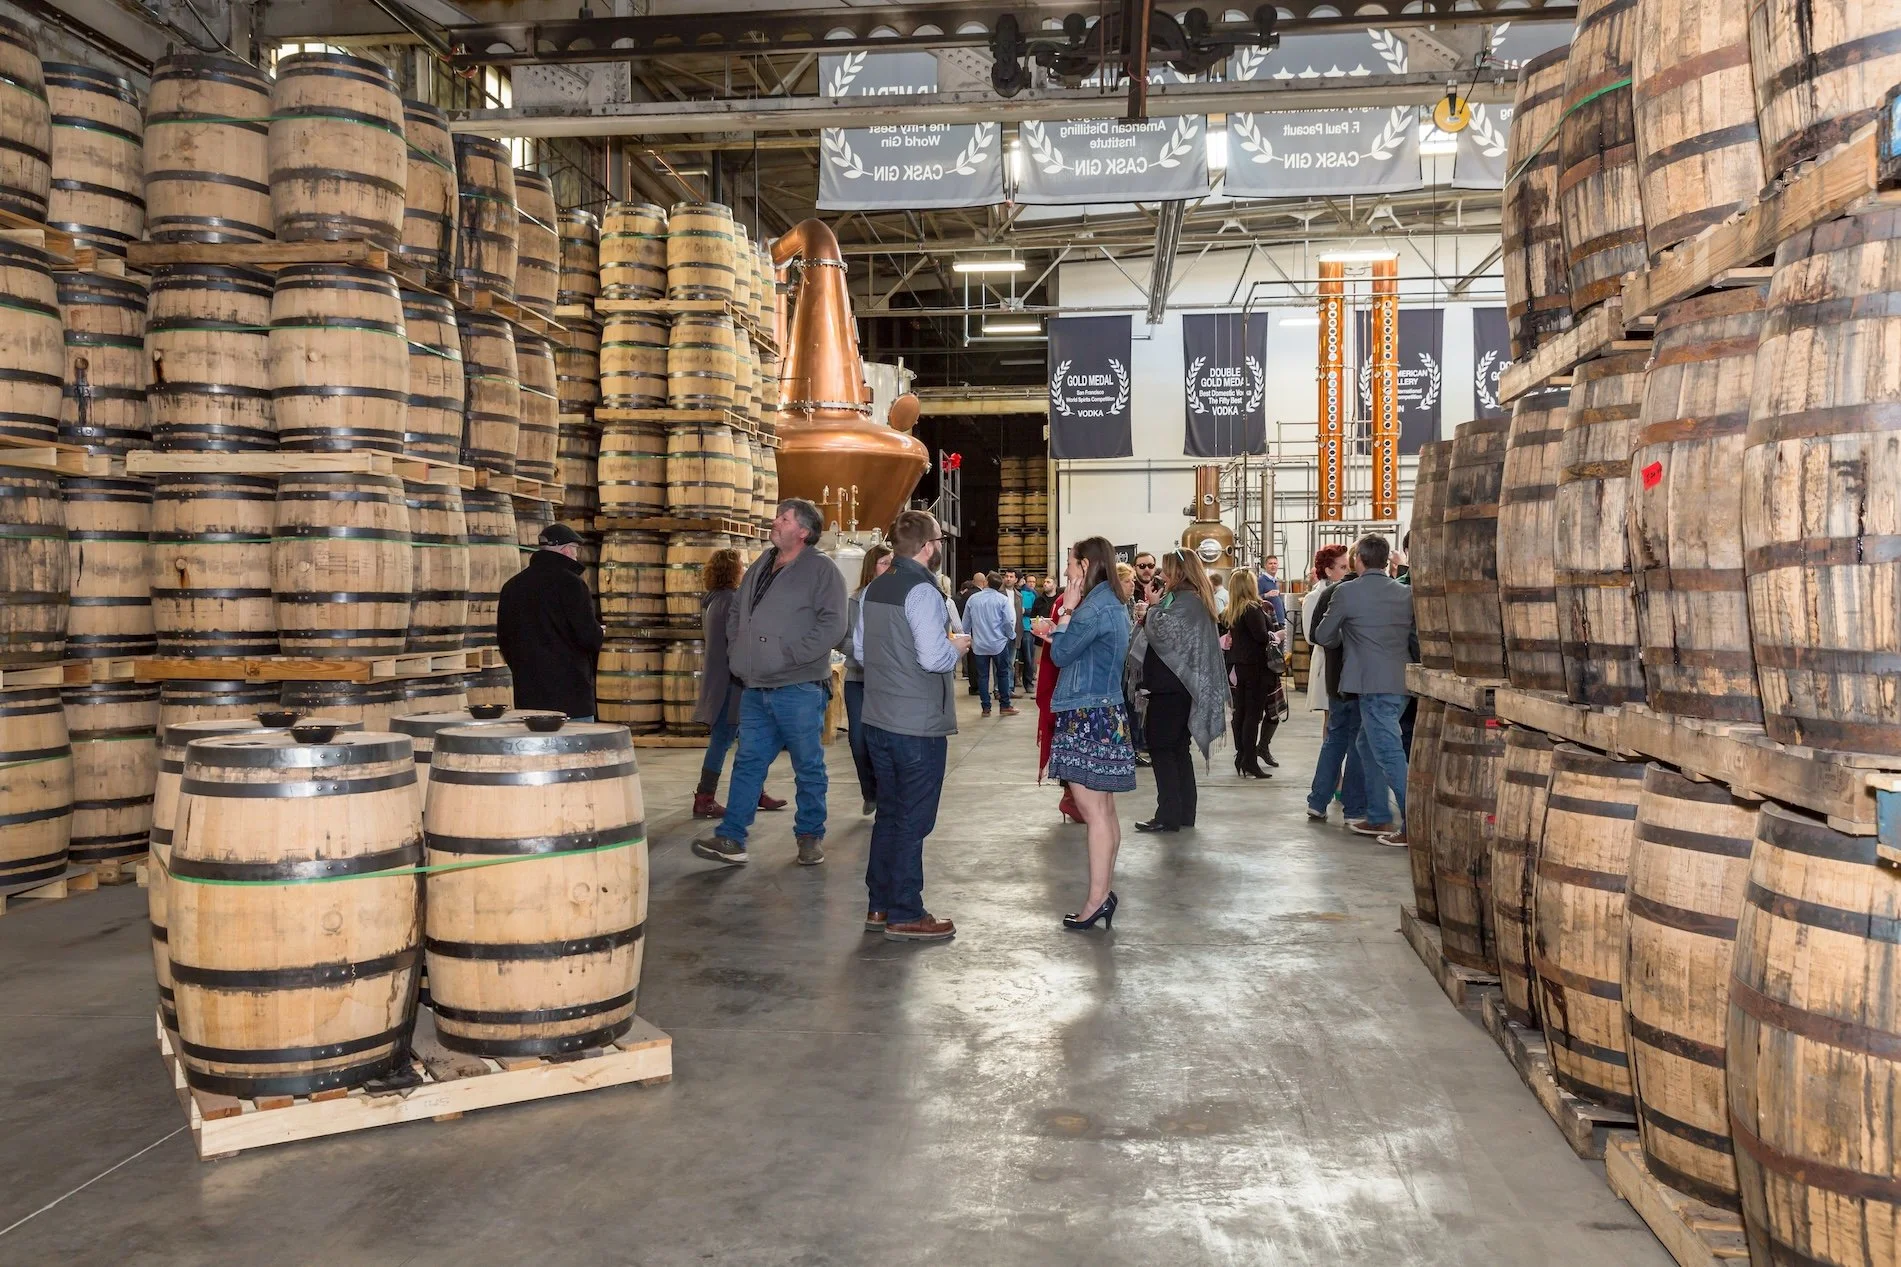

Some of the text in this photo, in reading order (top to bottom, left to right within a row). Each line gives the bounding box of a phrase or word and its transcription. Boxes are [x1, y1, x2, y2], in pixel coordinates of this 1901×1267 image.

[1210, 367, 1241, 378] DOUBLE
[1397, 369, 1428, 377] MERICAN
[1066, 374, 1114, 387] GOLD MEDAL
[1200, 376, 1250, 388] GOLD MEDAL
[1199, 389, 1211, 397] Best
[1211, 389, 1235, 397] Domestic
[1230, 396, 1243, 404] Best
[1077, 409, 1104, 417] VODKA
[1211, 405, 1239, 416] VODKA
[1397, 404, 1405, 413] IN
